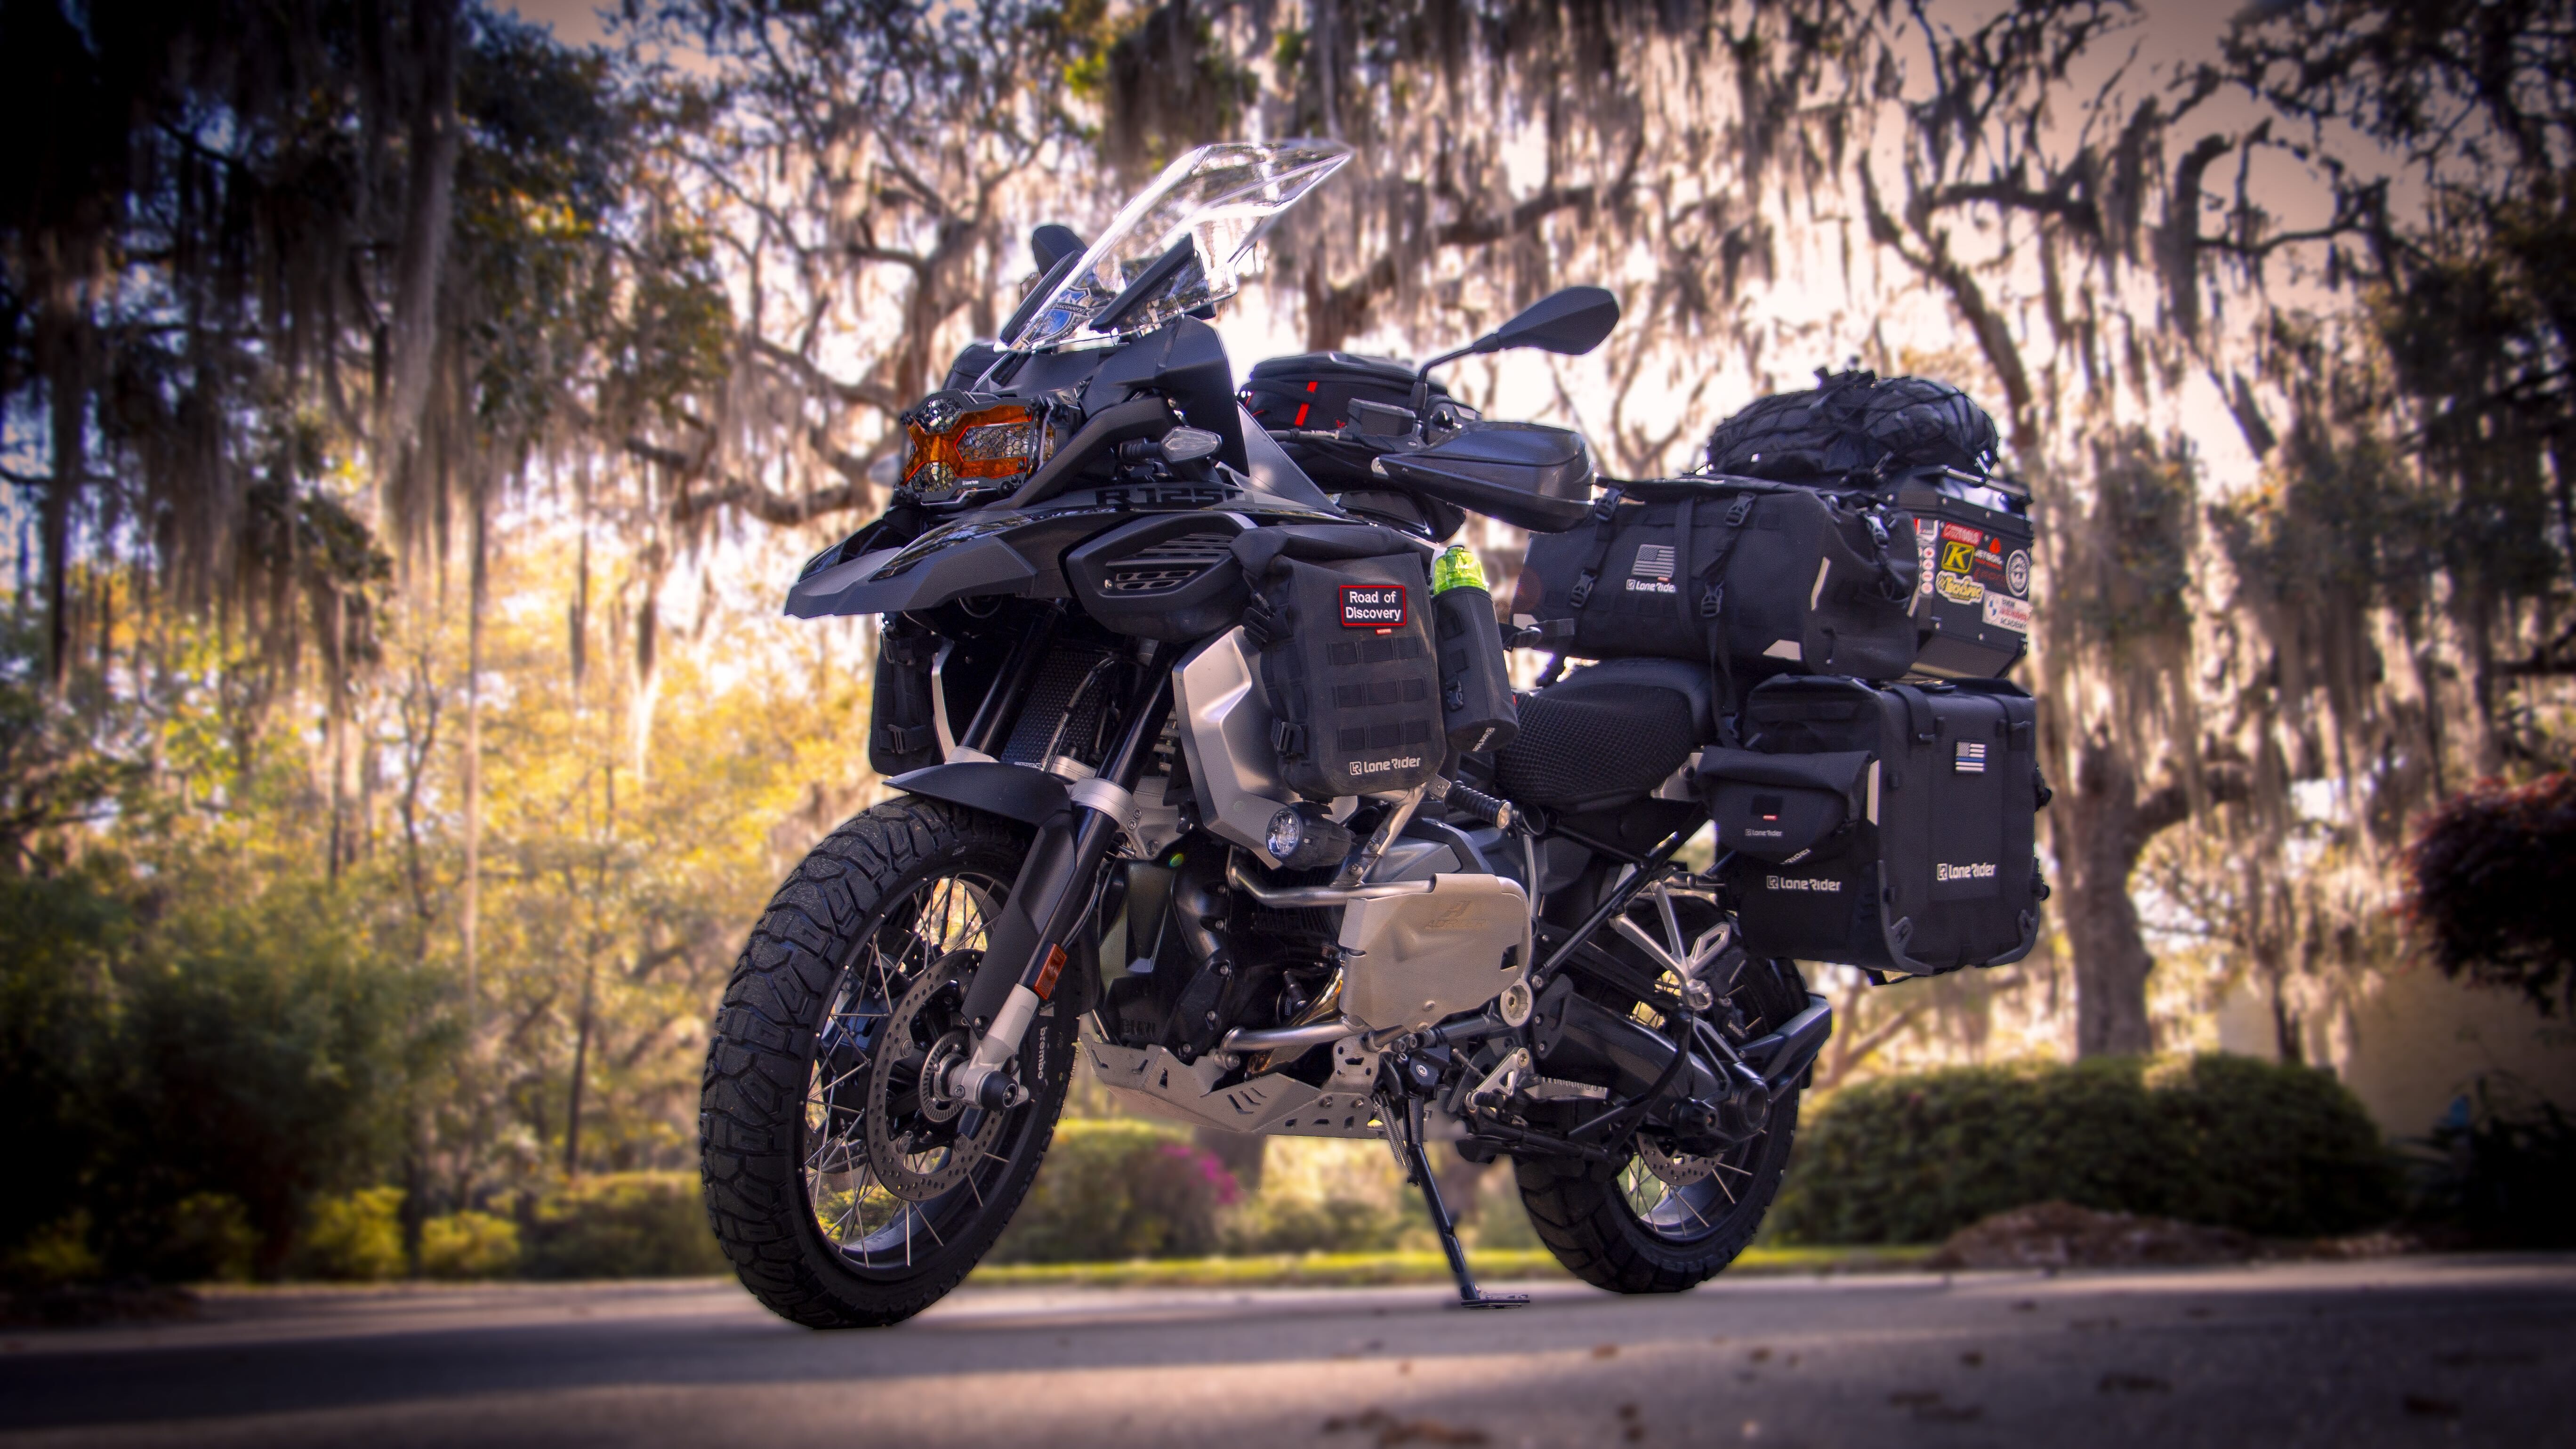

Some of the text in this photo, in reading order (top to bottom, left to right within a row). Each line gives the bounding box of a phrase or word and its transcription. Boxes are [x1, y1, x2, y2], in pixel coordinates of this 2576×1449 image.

[1945, 545, 1972, 569] K
[1635, 580, 1656, 592] Lone
[1349, 591, 1396, 603] Road of
[1345, 606, 1401, 621] Discovery
[1472, 733, 1492, 752] Lone Rider
[1364, 761, 1390, 773] Lone
[1391, 756, 1421, 769] Rider
[1948, 864, 1971, 879] Lone
[1971, 862, 1996, 877] Rider
[1781, 877, 1809, 890] Lone
[1809, 878, 1842, 892] Rider
[1038, 1026, 1047, 1079] brembo
